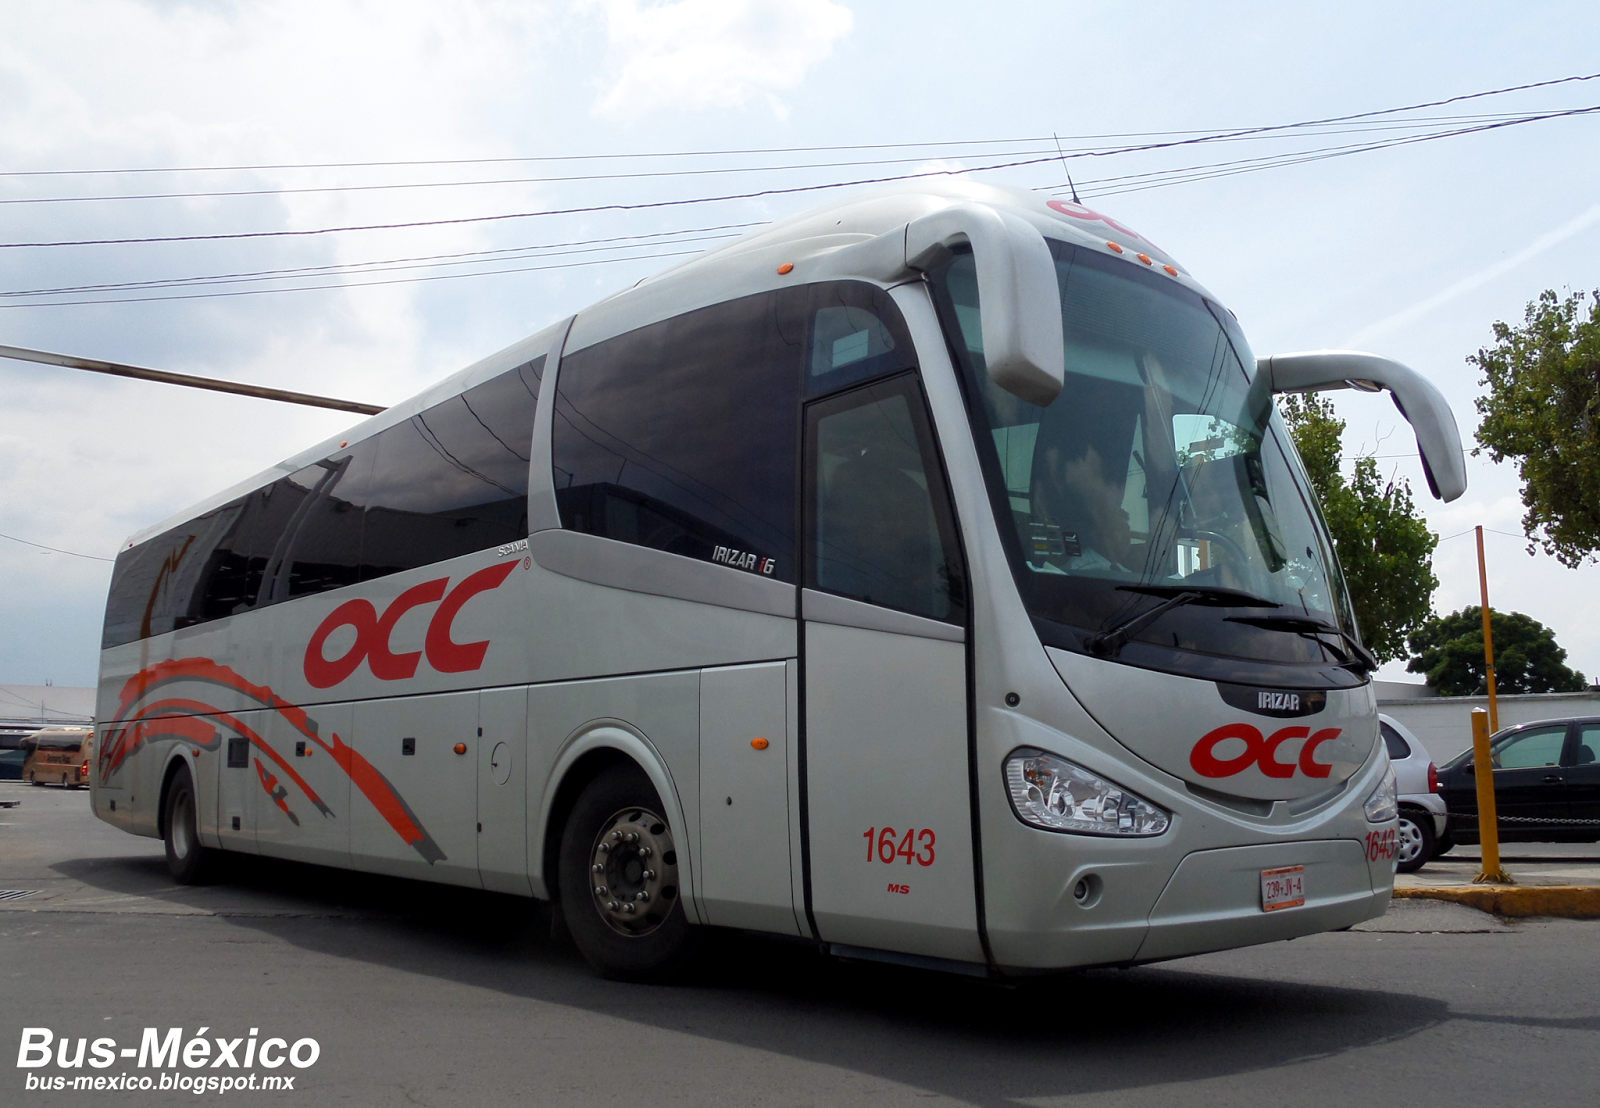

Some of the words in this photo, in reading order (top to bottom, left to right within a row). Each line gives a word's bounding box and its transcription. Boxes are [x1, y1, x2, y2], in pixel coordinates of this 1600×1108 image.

[712, 545, 757, 570] IRIZAR
[759, 557, 776, 574] i6
[303, 558, 522, 689] OCC
[1258, 691, 1300, 711] IRIZAR
[1189, 723, 1343, 778] OCC
[863, 826, 937, 867] 1643
[1365, 828, 1395, 862] 1643
[887, 883, 910, 894] MS
